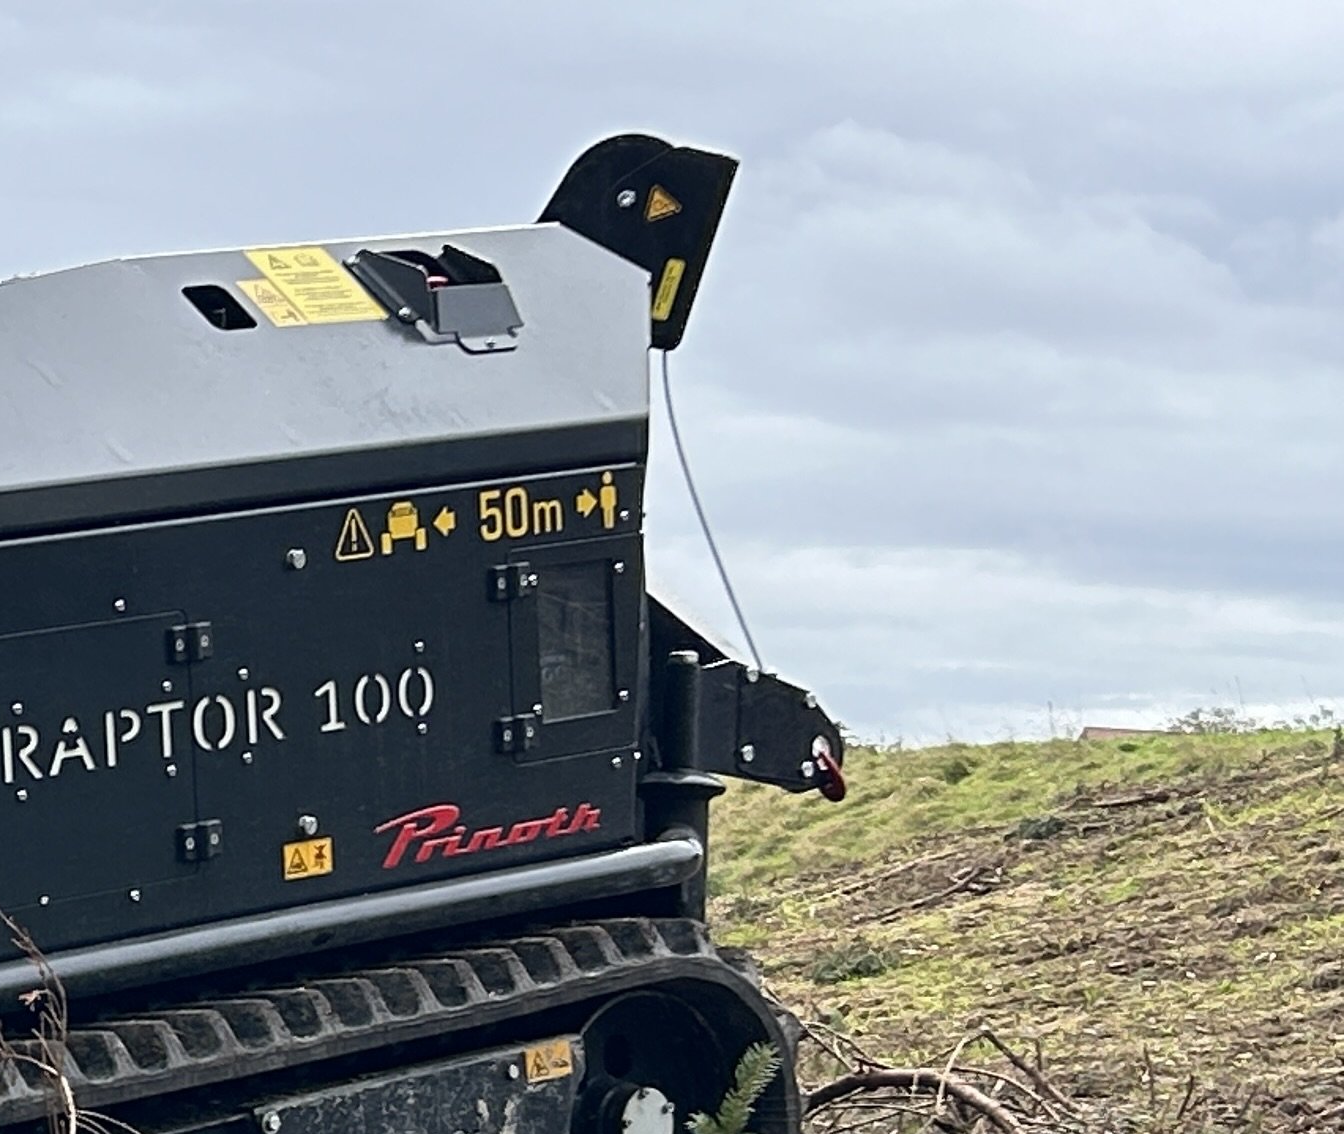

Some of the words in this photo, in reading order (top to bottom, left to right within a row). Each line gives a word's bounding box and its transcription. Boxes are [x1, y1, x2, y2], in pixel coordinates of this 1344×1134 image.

[479, 486, 563, 541] 50m
[2, 686, 286, 783] RAPTOR
[314, 666, 433, 732] 100
[373, 802, 601, 869] Prinoth
